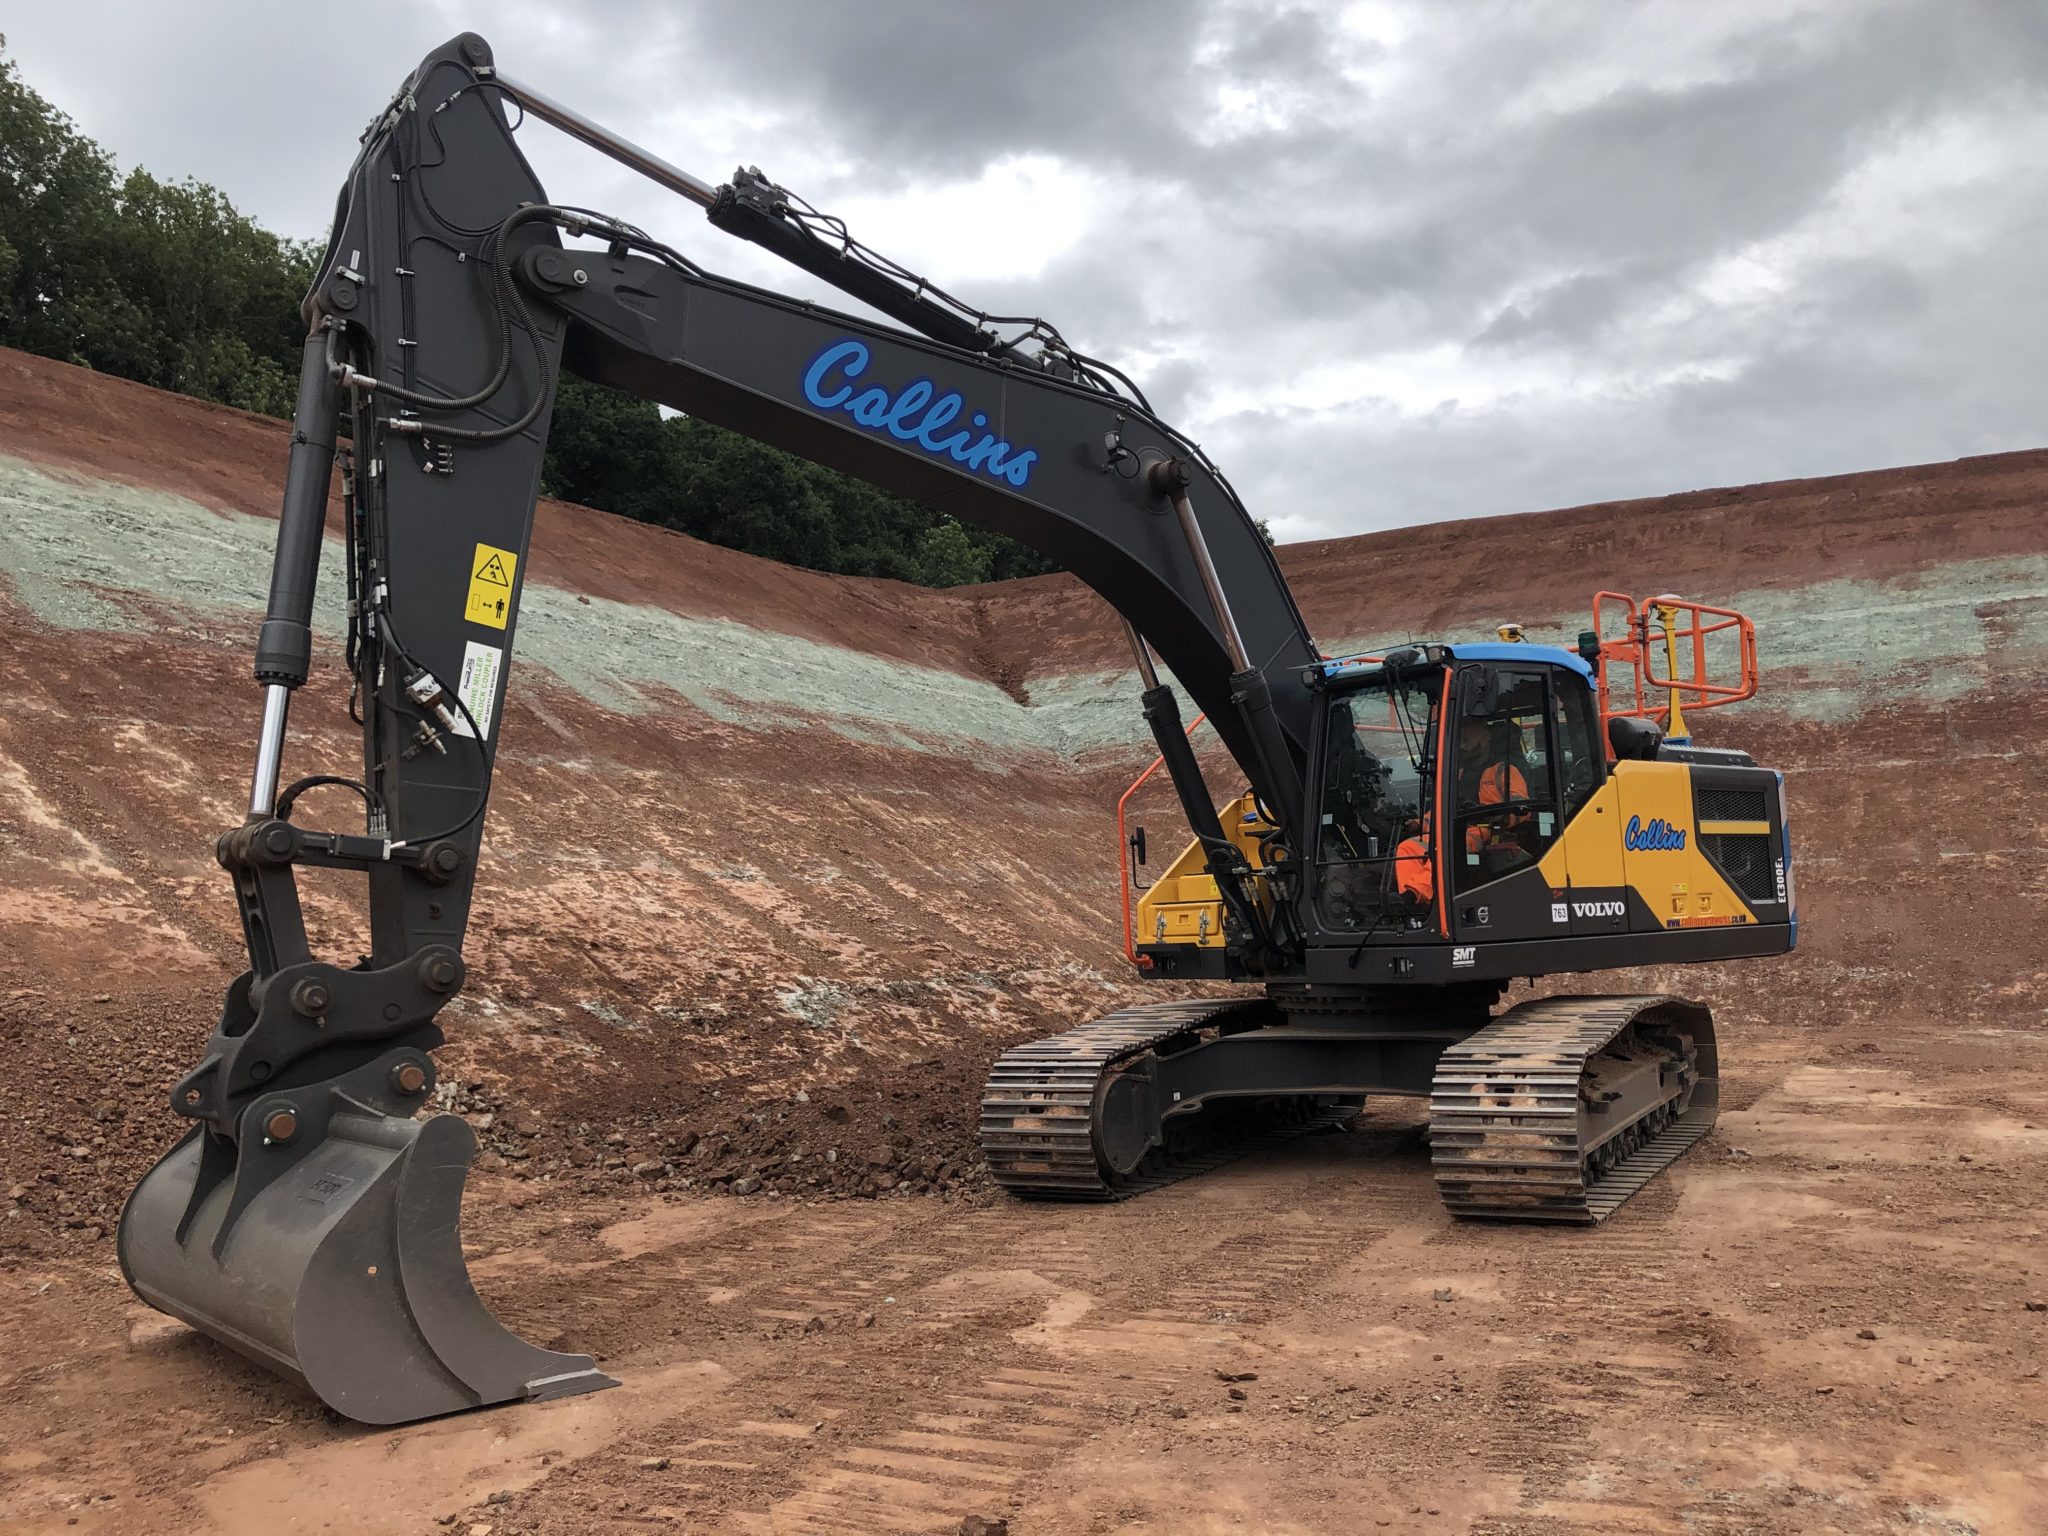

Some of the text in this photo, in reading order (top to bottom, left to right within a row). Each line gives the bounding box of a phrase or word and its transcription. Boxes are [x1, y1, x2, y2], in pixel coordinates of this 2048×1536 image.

[803, 338, 1039, 488] Collins
[473, 656, 483, 686] MILLER
[475, 652, 493, 727] WINLOCK COUPLER
[1625, 815, 1686, 851] Collins
[1553, 907, 1567, 918] 763
[1572, 901, 1625, 917] VOLVO
[1453, 947, 1476, 960] SMT
